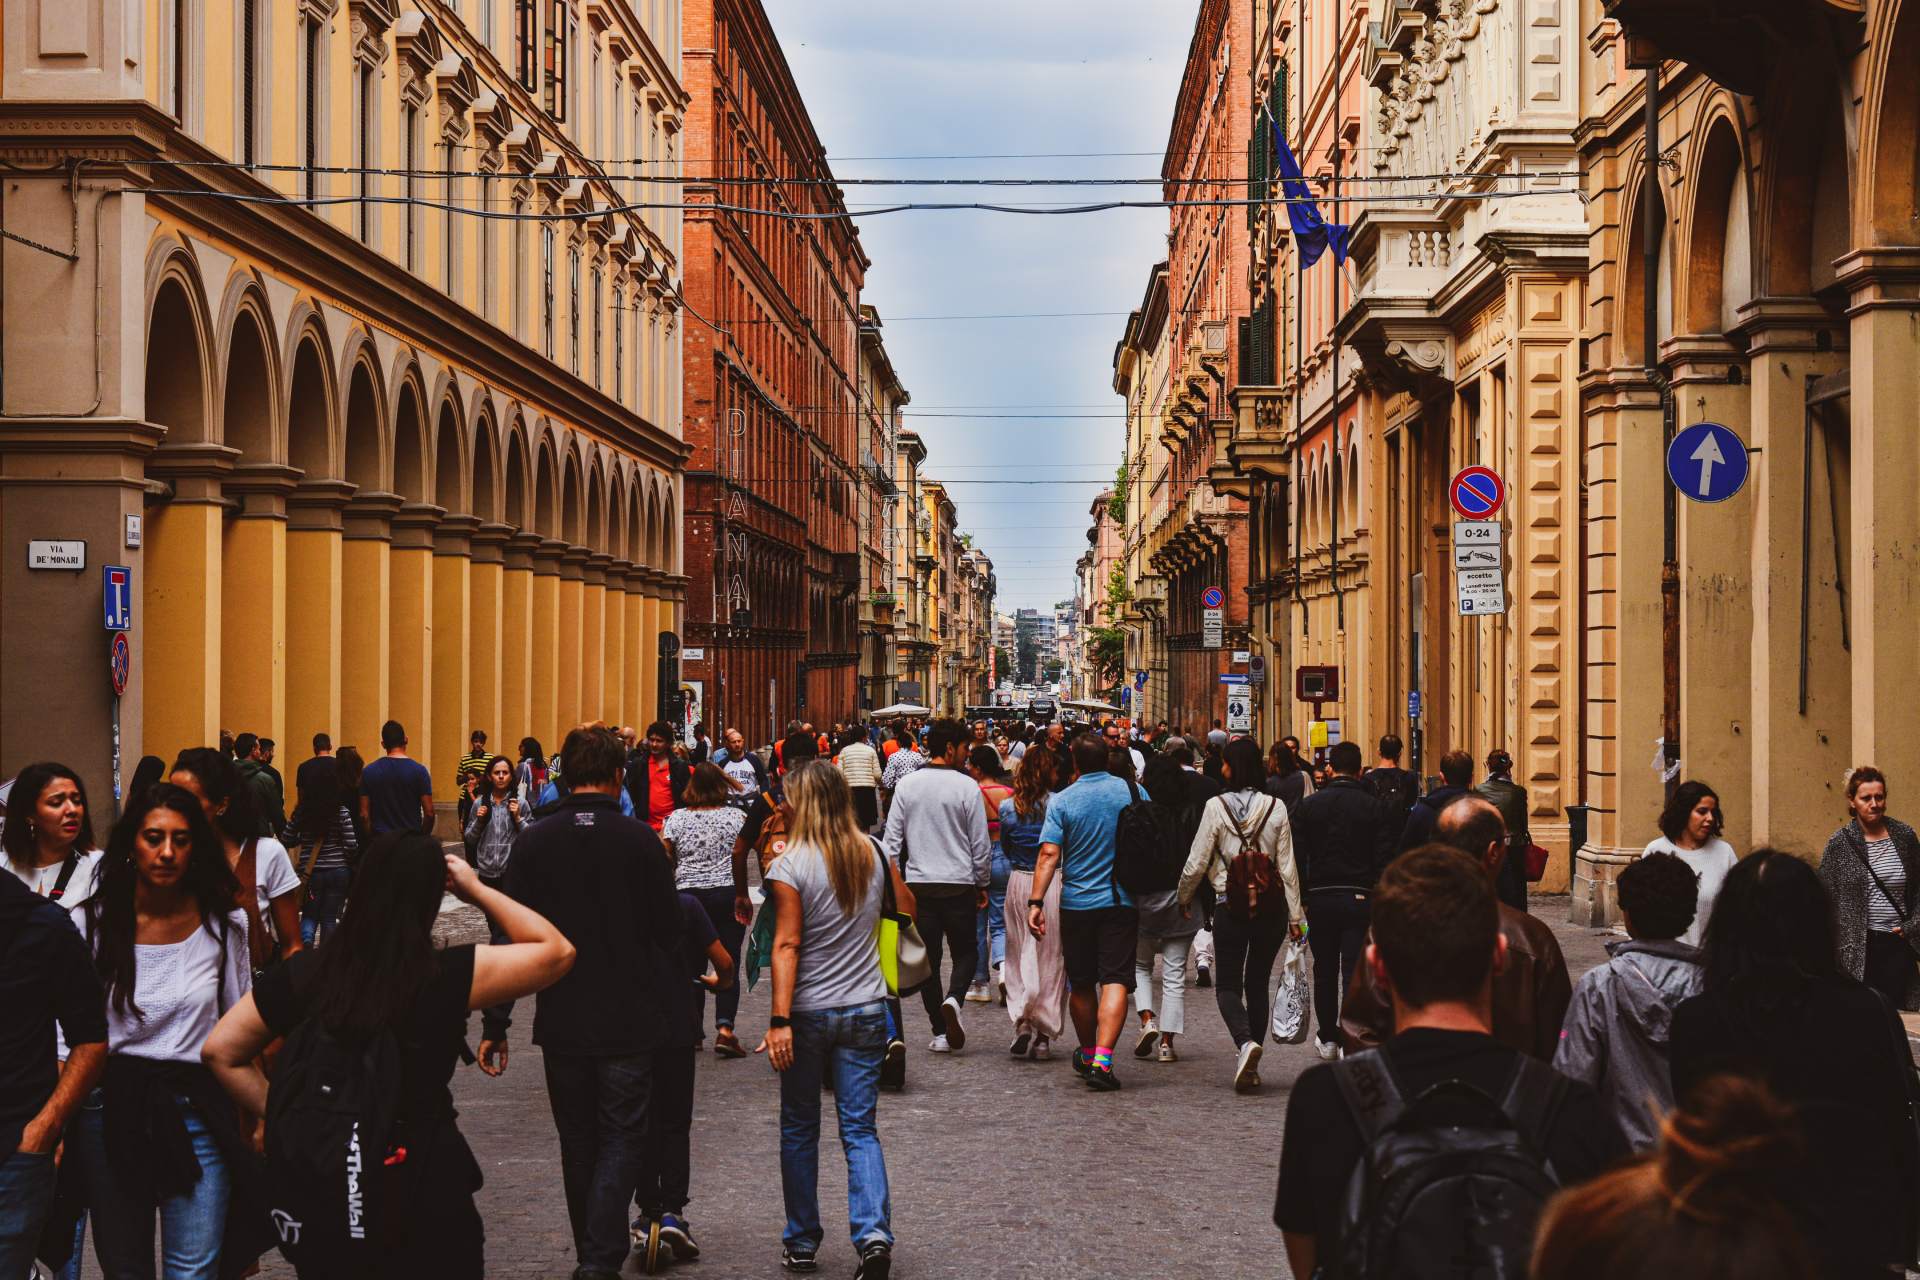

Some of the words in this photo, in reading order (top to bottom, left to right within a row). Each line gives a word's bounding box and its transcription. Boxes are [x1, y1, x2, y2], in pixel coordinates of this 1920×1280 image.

[727, 408, 748, 602] DIANA
[1465, 528, 1490, 538] 0-24
[50, 545, 63, 553] VIA
[50, 556, 79, 564] MONARI
